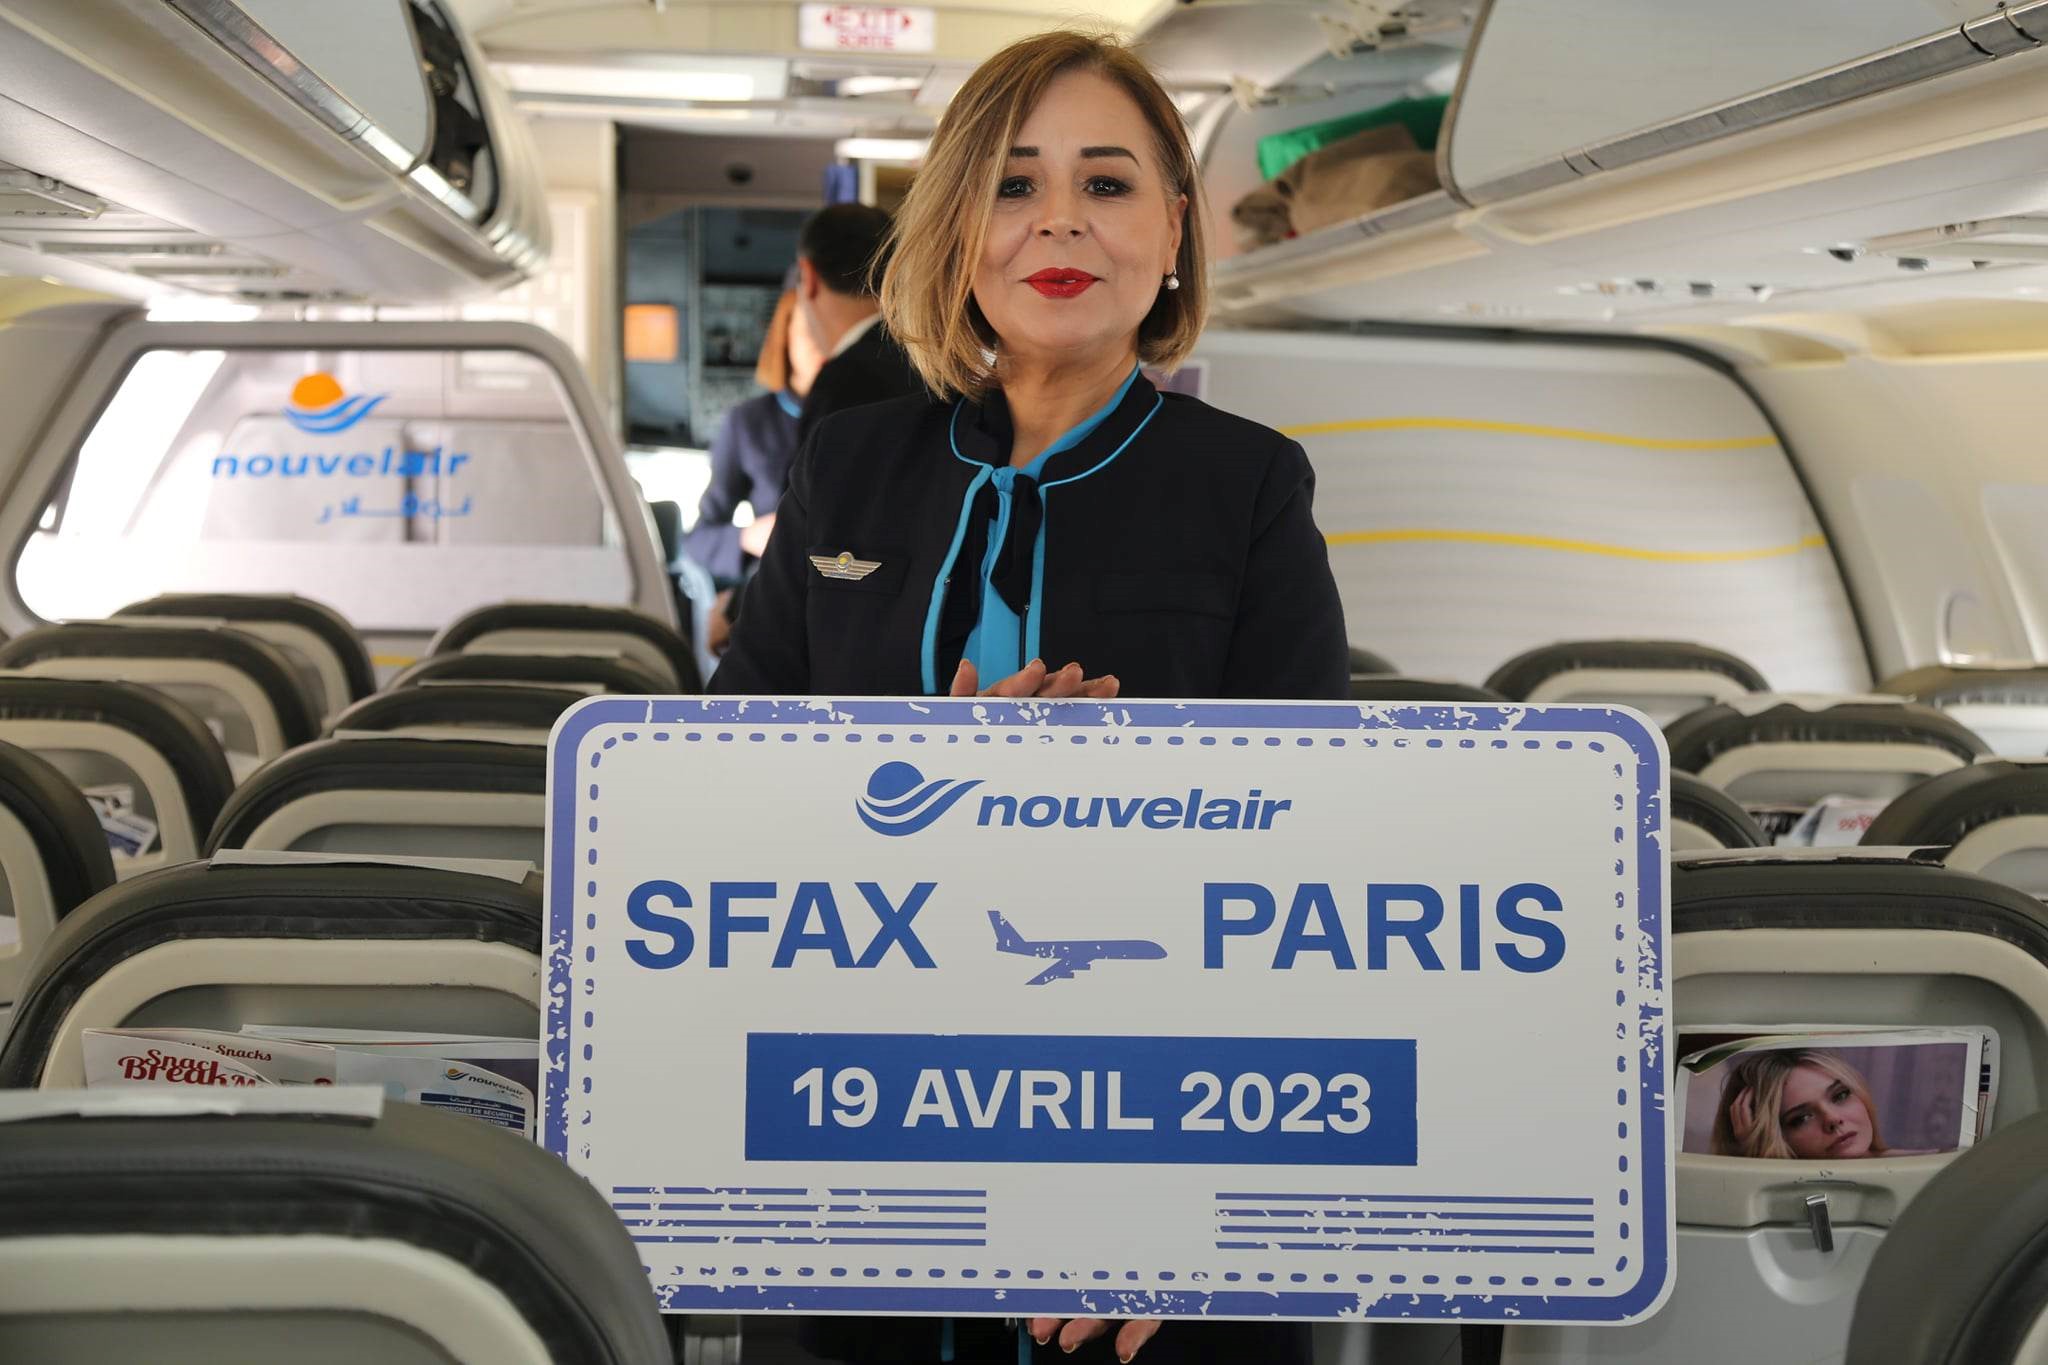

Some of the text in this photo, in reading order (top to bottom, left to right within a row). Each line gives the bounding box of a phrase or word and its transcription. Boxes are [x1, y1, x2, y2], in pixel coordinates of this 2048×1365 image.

[212, 446, 470, 477] nouvelair
[976, 788, 1292, 831] nouvelair
[625, 880, 1567, 973] SFAX PARIS
[215, 1044, 272, 1061] Snacks
[117, 1056, 228, 1087] Break
[468, 1076, 525, 1096] nouvelair
[793, 1067, 1372, 1135] 19 AVRIL 2023
